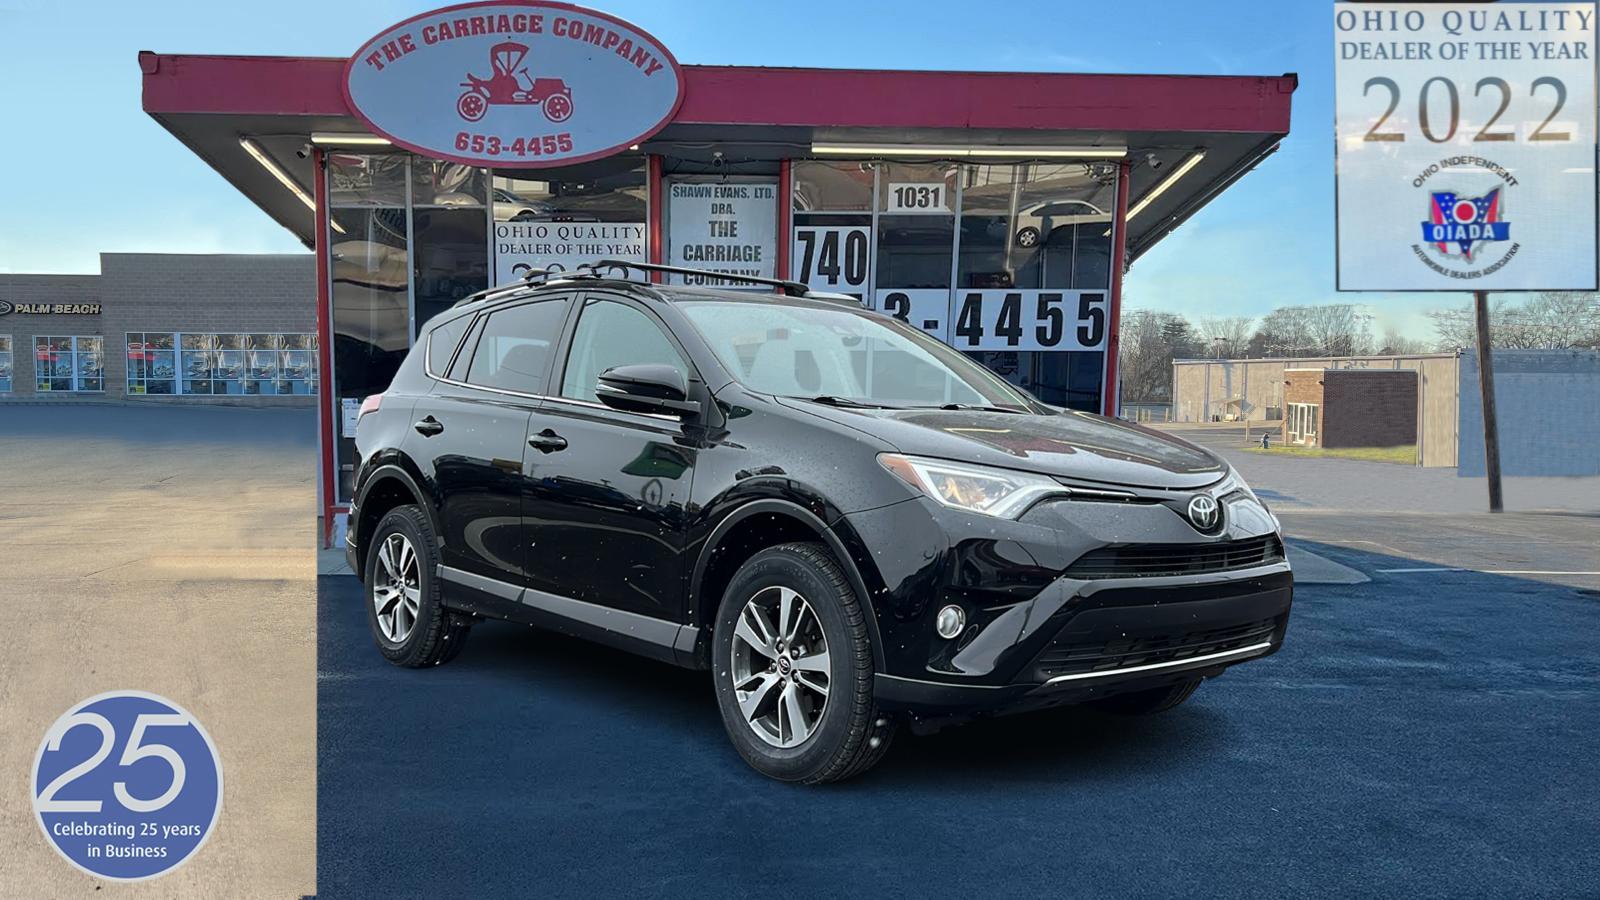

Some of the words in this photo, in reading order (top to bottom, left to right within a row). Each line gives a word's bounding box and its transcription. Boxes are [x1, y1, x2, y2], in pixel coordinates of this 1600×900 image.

[1336, 10, 1424, 31] OHIO
[1442, 10, 1593, 36] QUALITY
[365, 33, 417, 71] THE
[422, 14, 543, 45] CARRIAGE
[552, 17, 664, 77] COMPANY
[1340, 41, 1433, 60] DEALER
[1438, 41, 1469, 60] OF
[1475, 41, 1522, 60] THE
[1528, 41, 1589, 60] YEAR
[1362, 76, 1571, 143] 2022
[455, 132, 573, 156] 653-4455
[1412, 164, 1439, 188] OHIO
[1440, 156, 1519, 187] INDEPENDENT
[672, 185, 712, 198] SHAWN
[754, 187, 774, 199] LTD.
[894, 186, 940, 209] 1031
[711, 203, 736, 215] DBA.
[497, 226, 548, 238] OHIO
[557, 226, 644, 240] QUALITY
[708, 220, 737, 238] THE
[1432, 224, 1495, 240] OIADA
[499, 243, 551, 255] DEALER
[555, 243, 574, 255] OF
[576, 243, 603, 255] THE
[606, 243, 641, 255] YEAR
[683, 244, 762, 262] CARRIAGE
[798, 230, 867, 285] 740
[1411, 243, 1450, 277] AUTOMOBILE
[1450, 270, 1482, 279] DEALERS
[1483, 242, 1521, 276] ASSOCIATION
[14, 303, 51, 314] PALM
[54, 303, 100, 314] BEACH
